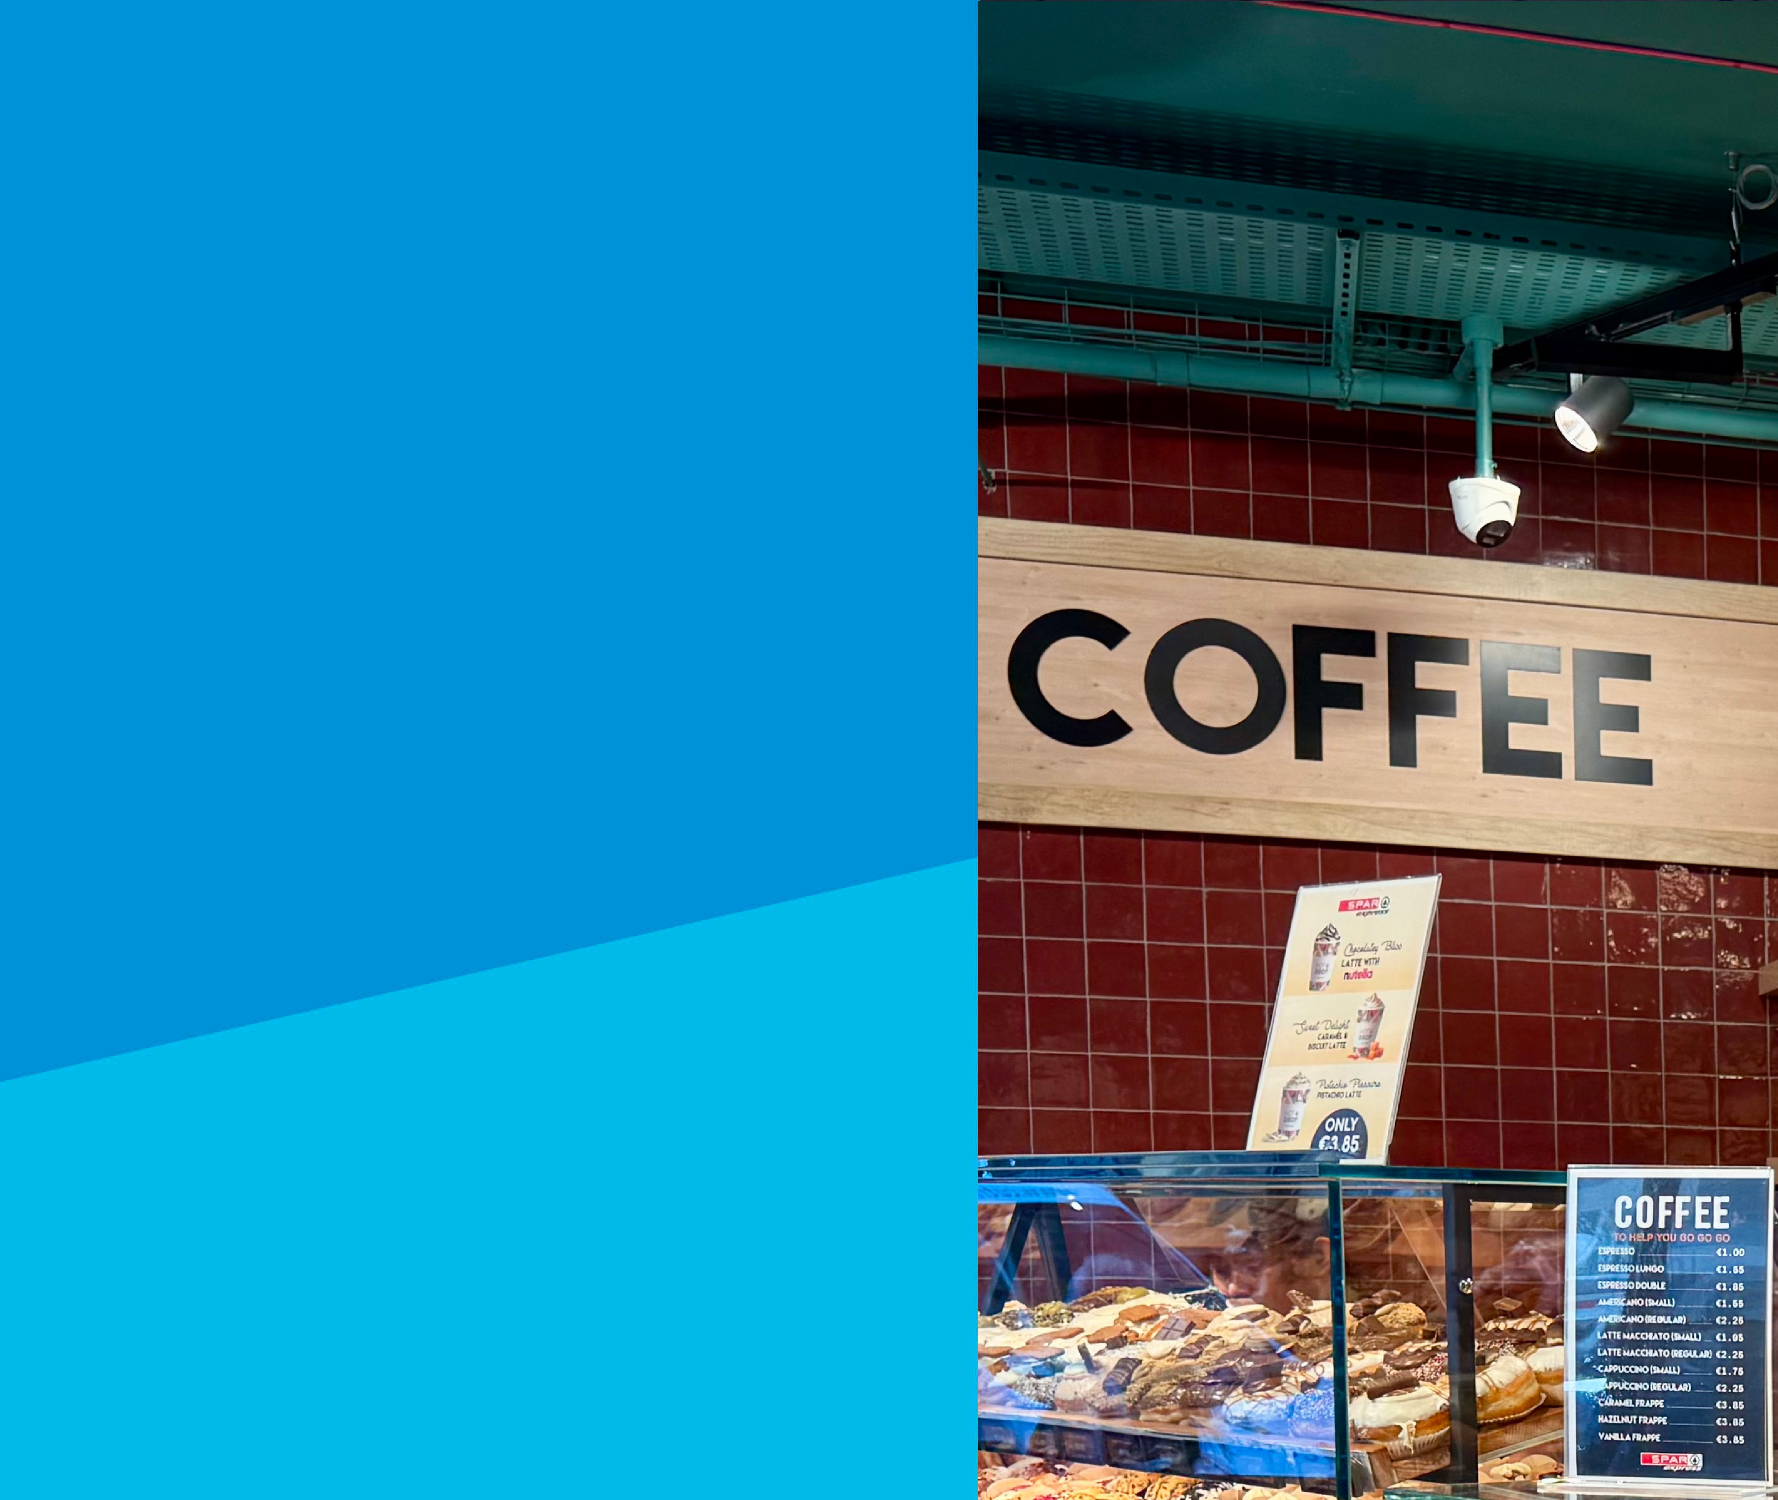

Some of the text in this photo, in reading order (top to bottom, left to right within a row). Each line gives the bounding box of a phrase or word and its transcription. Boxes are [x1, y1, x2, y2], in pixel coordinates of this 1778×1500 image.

[1006, 607, 1655, 788] COFFEE
[1347, 900, 1379, 910] SPAR
[1341, 957, 1380, 967] LATTE WITH
[1343, 970, 1373, 981] nutella
[1325, 1117, 1359, 1132] ONLY
[1318, 1134, 1360, 1152] €3.85
[1614, 1195, 1730, 1229] COFFEE
[1614, 1233, 1730, 1243] TO HELP YOU GO GO GO
[1598, 1247, 1745, 1257] ESPRESSO €1.00
[1598, 1265, 1635, 1273] ESPRESSO
[1636, 1265, 1664, 1273] LUNGO
[1651, 1455, 1688, 1464] SPAR
